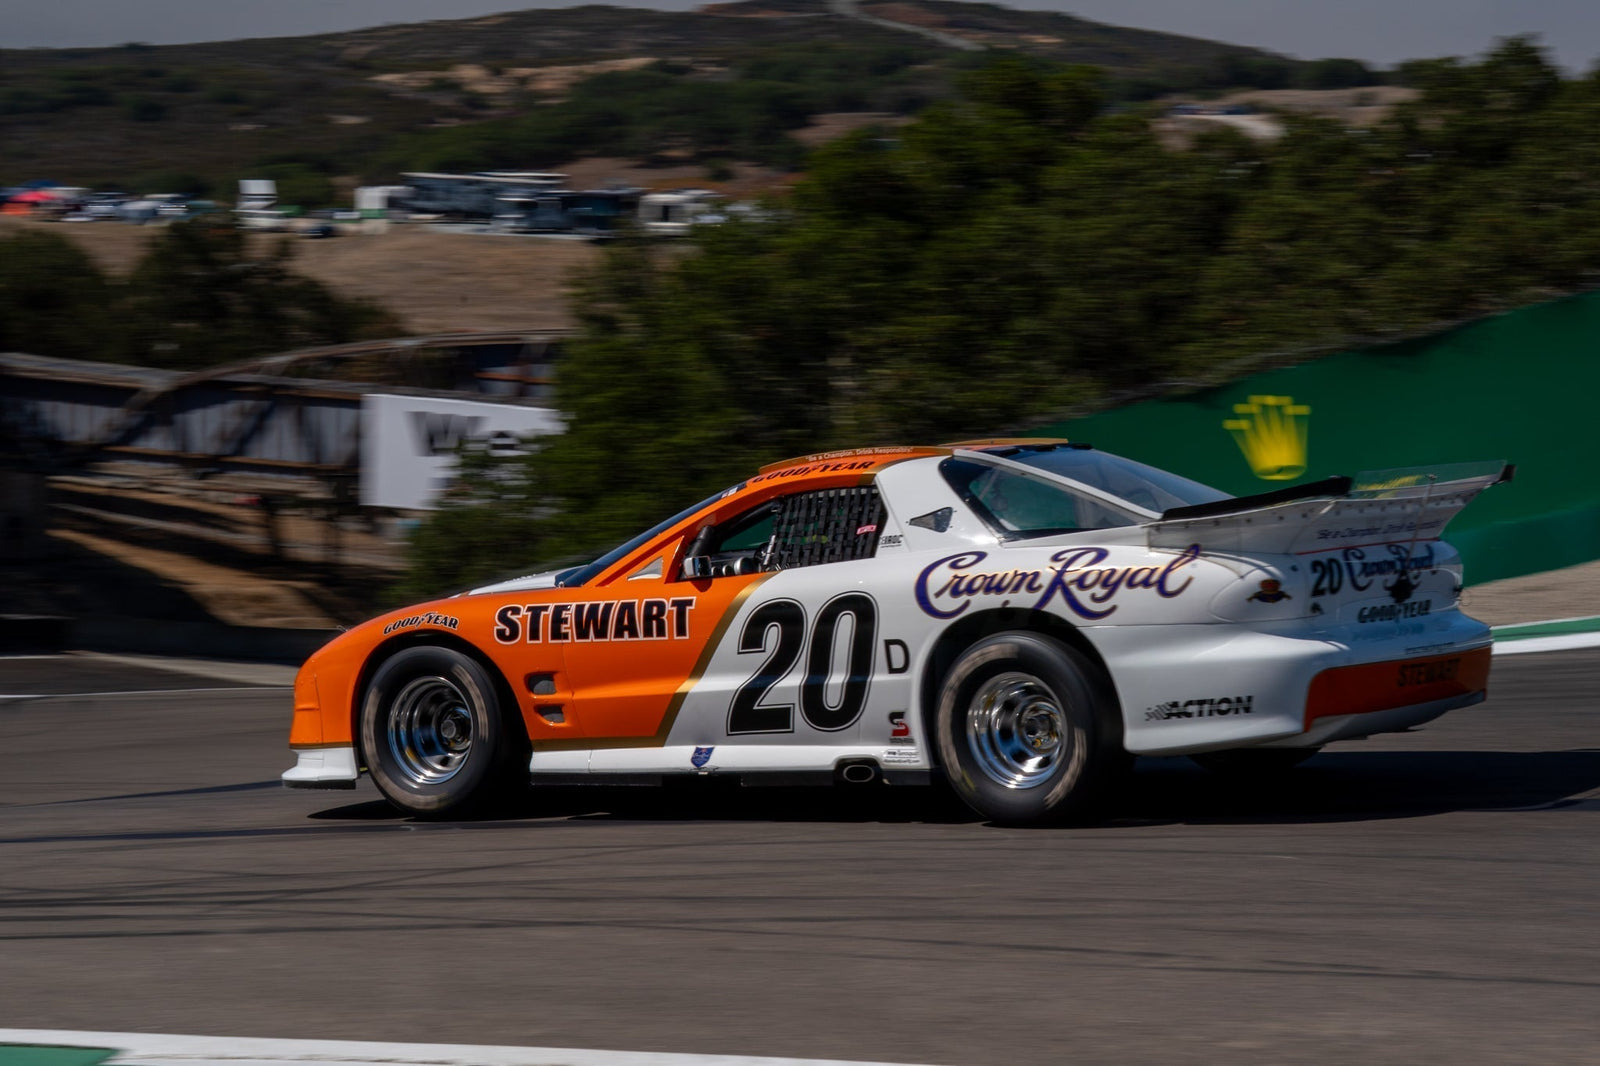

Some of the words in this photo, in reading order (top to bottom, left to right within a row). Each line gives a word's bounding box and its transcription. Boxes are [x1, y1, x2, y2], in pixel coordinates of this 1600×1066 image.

[752, 461, 875, 483] GOODYEAR
[914, 550, 1043, 620] Crown
[1026, 544, 1201, 620] Royal
[1311, 558, 1343, 597] 20
[1342, 547, 1397, 591] Crown
[383, 611, 460, 635] GOODYEAR
[494, 596, 697, 645] STEWART
[1357, 599, 1433, 624] GOODYEAR
[726, 590, 880, 736] 20
[884, 638, 911, 674] D
[1163, 695, 1254, 720] ACTION
